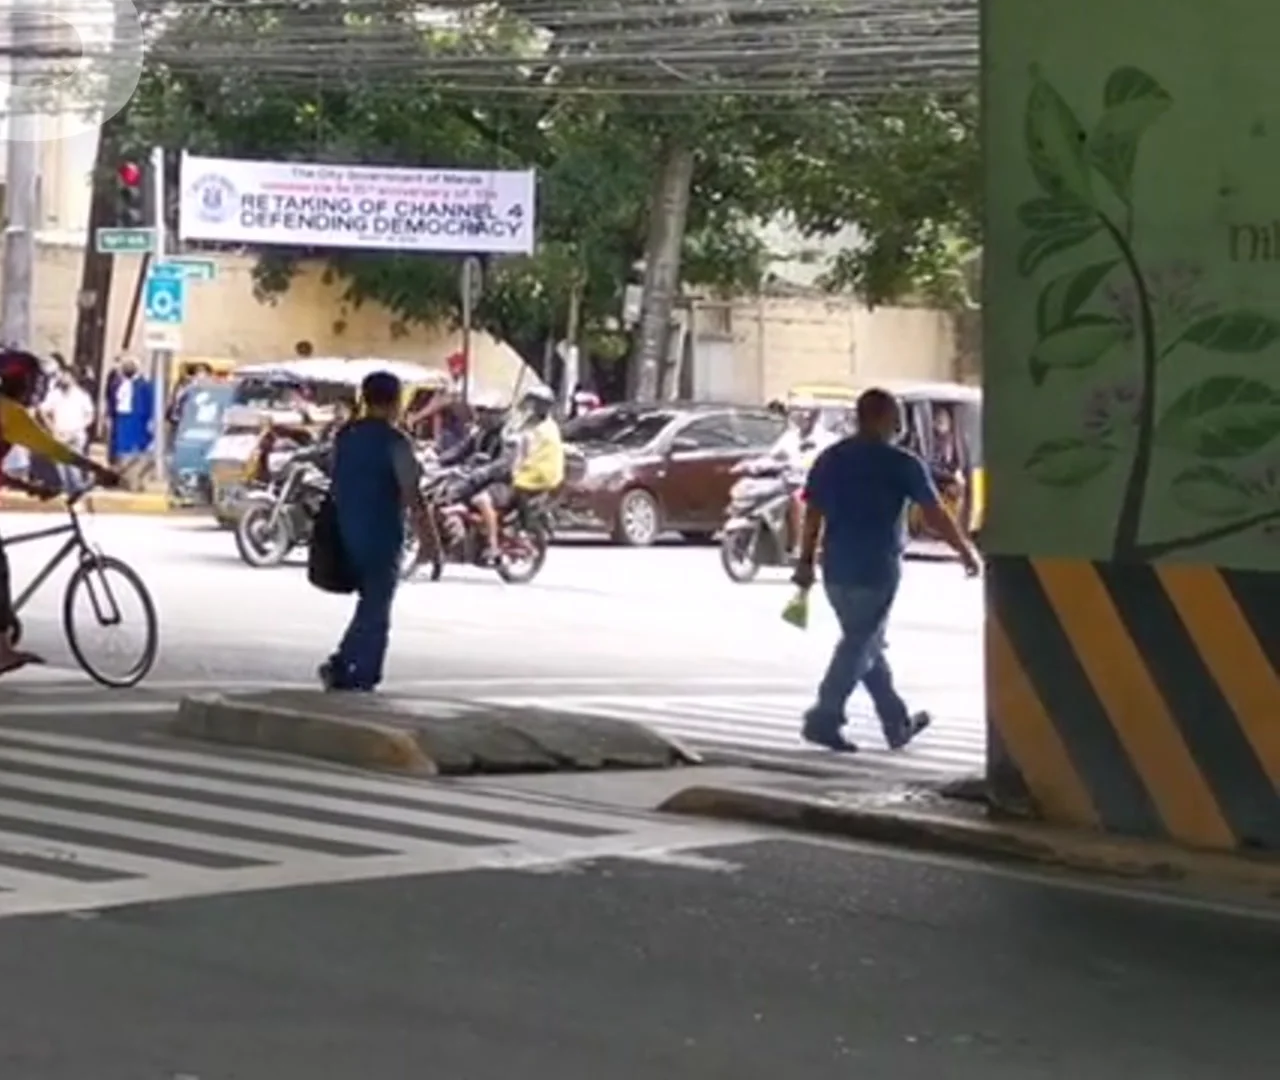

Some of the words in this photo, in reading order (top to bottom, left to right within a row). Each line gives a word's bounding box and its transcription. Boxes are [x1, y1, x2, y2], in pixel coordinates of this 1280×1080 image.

[291, 167, 315, 178] The
[317, 168, 344, 181] City
[426, 173, 441, 184] of
[240, 193, 353, 215] RETAKING
[358, 198, 387, 215] OF
[394, 200, 497, 220] CHANNEL
[507, 203, 524, 219] 4
[240, 210, 368, 233] DEFENDING
[373, 217, 524, 239] DEMOCRACY
